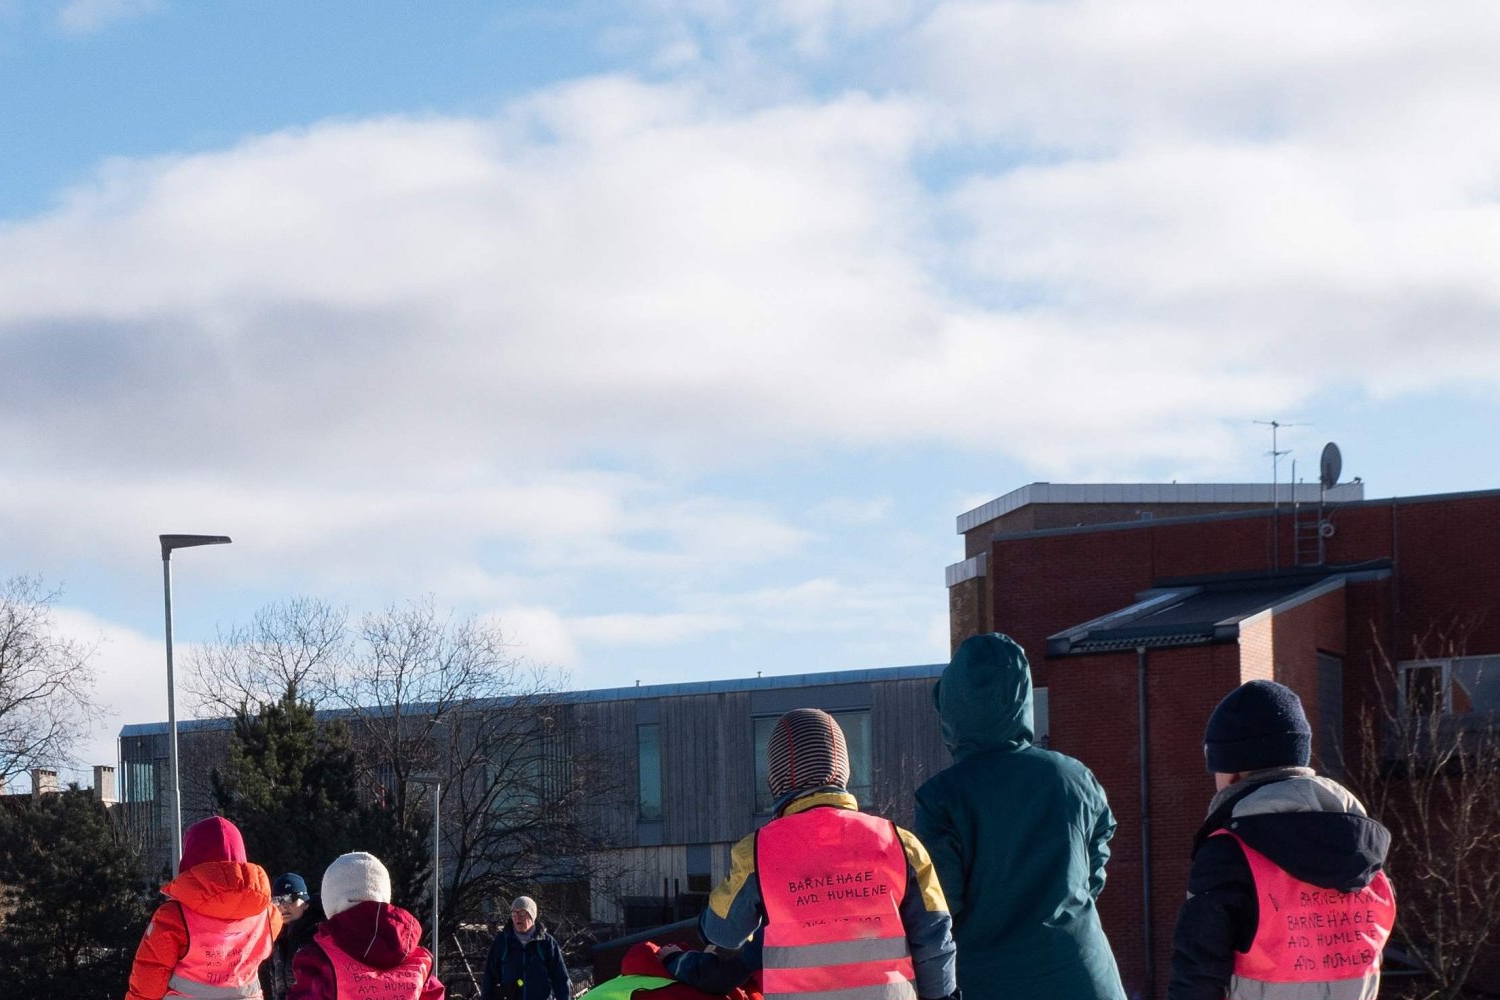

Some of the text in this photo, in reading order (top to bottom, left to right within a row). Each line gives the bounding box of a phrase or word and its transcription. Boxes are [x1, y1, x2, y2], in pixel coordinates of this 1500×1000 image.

[788, 871, 874, 893] BARNEHAGE
[796, 884, 887, 906] AVD. HUMLENE
[1287, 911, 1375, 930] BARNEHAGE
[357, 985, 377, 995] AVD
